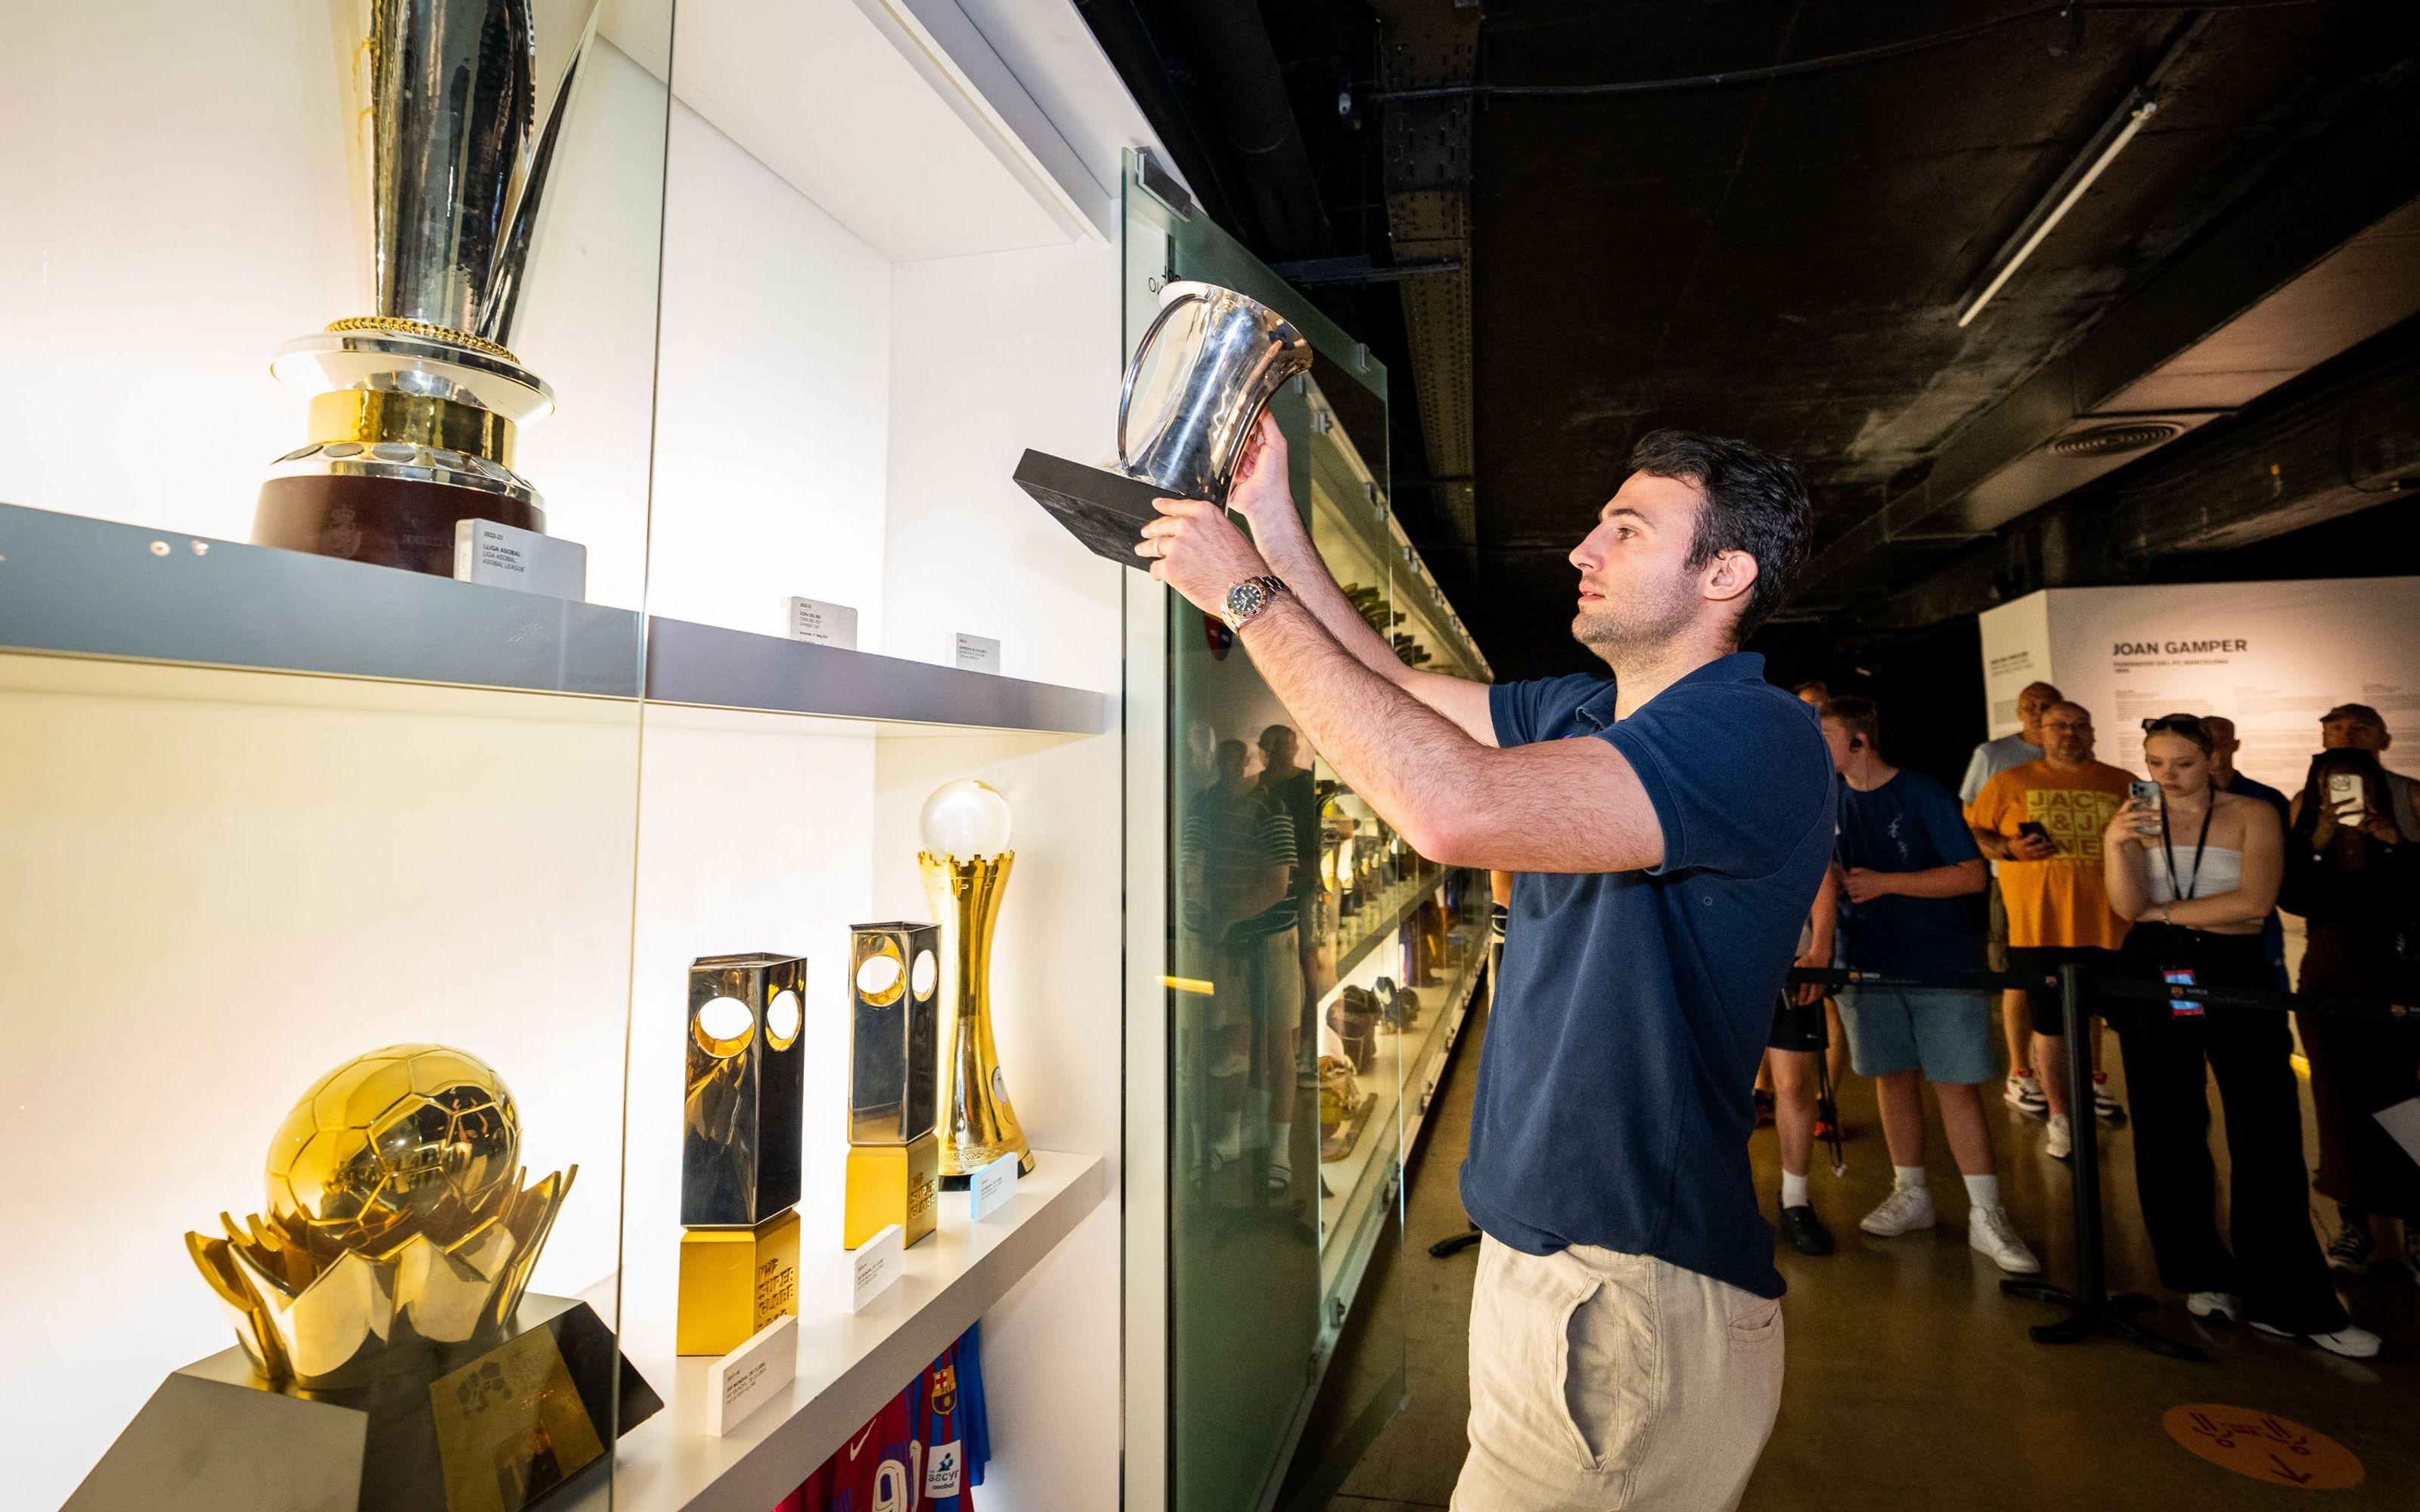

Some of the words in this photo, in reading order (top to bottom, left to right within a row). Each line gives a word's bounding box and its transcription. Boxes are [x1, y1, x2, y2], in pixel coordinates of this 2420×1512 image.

[482, 544, 499, 552] LLIGA
[501, 547, 521, 557] ASOBAL
[482, 559, 504, 568] ASOBAL
[504, 563, 526, 573] LEAGUE
[496, 554, 516, 564] ASOBAL
[2113, 643, 2160, 656] JOAN
[2164, 639, 2248, 655] GAMPER
[910, 1179, 936, 1204] SUPER
[910, 1193, 936, 1219] GLOBE
[758, 1266, 794, 1300] SUPER
[758, 1284, 794, 1318] GLOBE
[928, 1469, 959, 1482] sacyr
[932, 1481, 955, 1490] asobal
